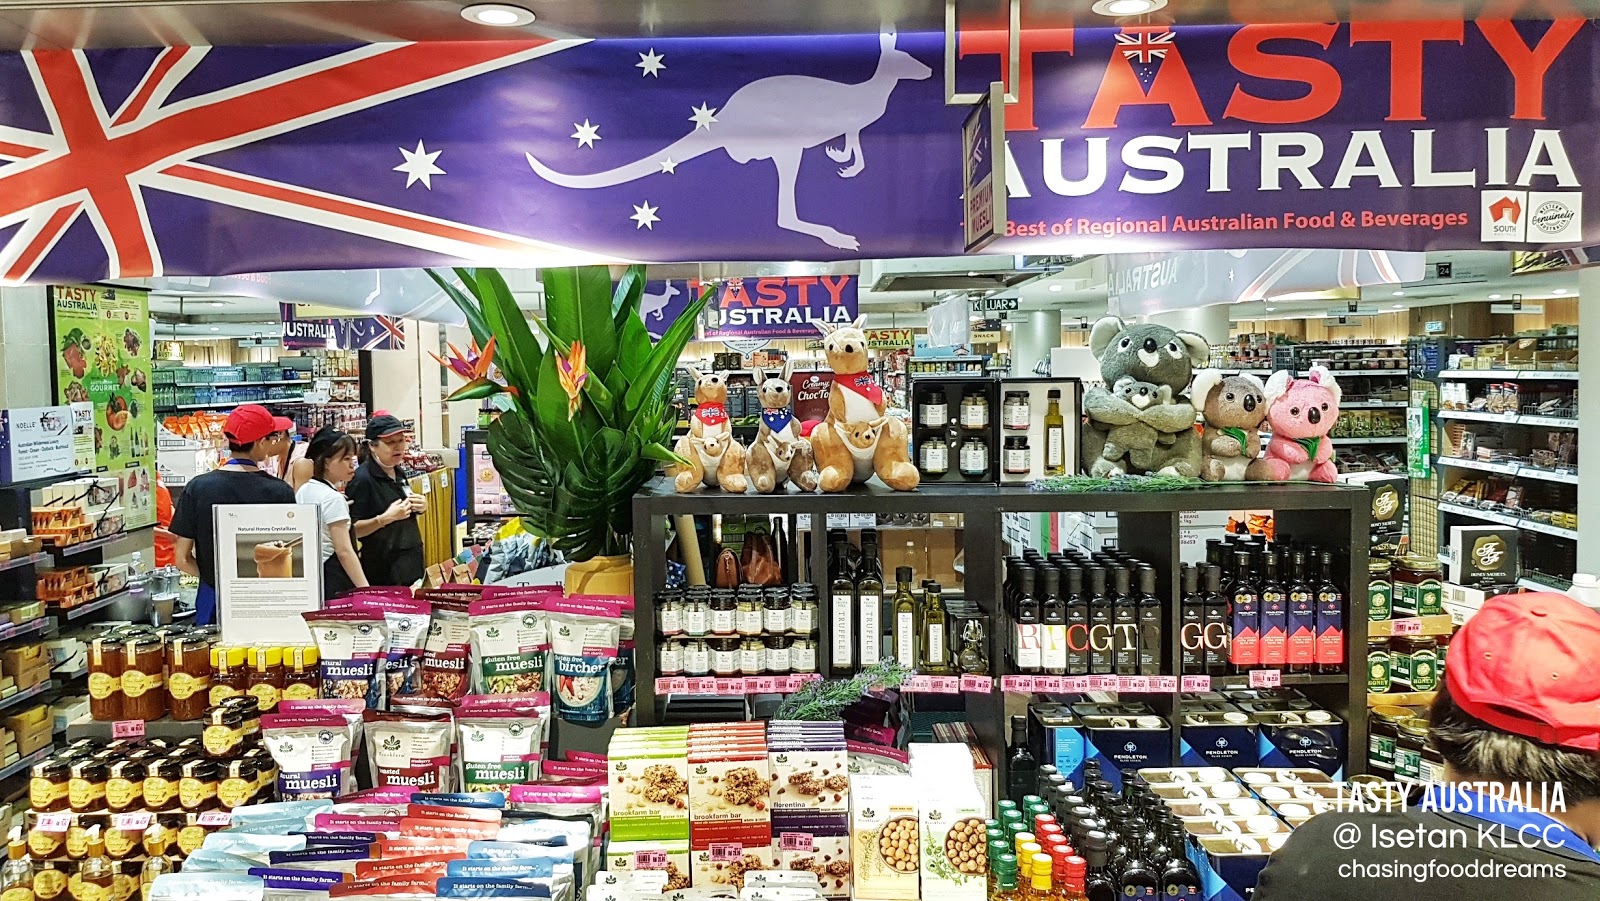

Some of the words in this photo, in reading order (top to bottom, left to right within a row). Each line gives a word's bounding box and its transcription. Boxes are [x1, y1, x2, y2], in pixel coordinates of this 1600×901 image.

[958, 20, 1589, 131] TASTY
[970, 182, 992, 214] PREMIUM
[971, 204, 992, 234] MUESLI
[1004, 220, 1046, 237] Best
[1051, 218, 1072, 236] of
[1077, 215, 1167, 238] Regional
[1172, 213, 1278, 232] Australian
[1283, 211, 1335, 229] Food
[1340, 211, 1356, 228] &
[1361, 210, 1468, 230] Beverages
[1532, 210, 1575, 225] Genuinely
[1493, 225, 1517, 233] SOUTH
[1440, 267, 1450, 275] 24
[56, 285, 97, 302] TASTY
[57, 299, 98, 311] AUSTRALIA
[719, 306, 851, 326] USTRALIA
[864, 329, 910, 341] ASTY
[868, 339, 910, 347] USTRALIA
[802, 379, 830, 390] Creamy
[797, 389, 830, 401] ChocTo
[74, 409, 92, 418] TASTY
[838, 611, 846, 651] TRUFFLE
[1018, 624, 1041, 650] R
[1067, 624, 1089, 651] C
[1090, 624, 1114, 651] G
[1113, 624, 1138, 650] T
[1180, 622, 1204, 650] G
[1204, 622, 1227, 650] G
[326, 664, 373, 676] muesli
[385, 656, 409, 670] esli
[425, 657, 465, 669] muesli
[495, 655, 543, 672] muesli
[559, 660, 605, 673] bircher
[379, 767, 400, 775] oasted
[465, 762, 486, 770] gluten
[474, 766, 526, 780] muesli
[285, 774, 338, 790] muesli
[386, 770, 436, 786] muesli
[501, 865, 519, 873] family
